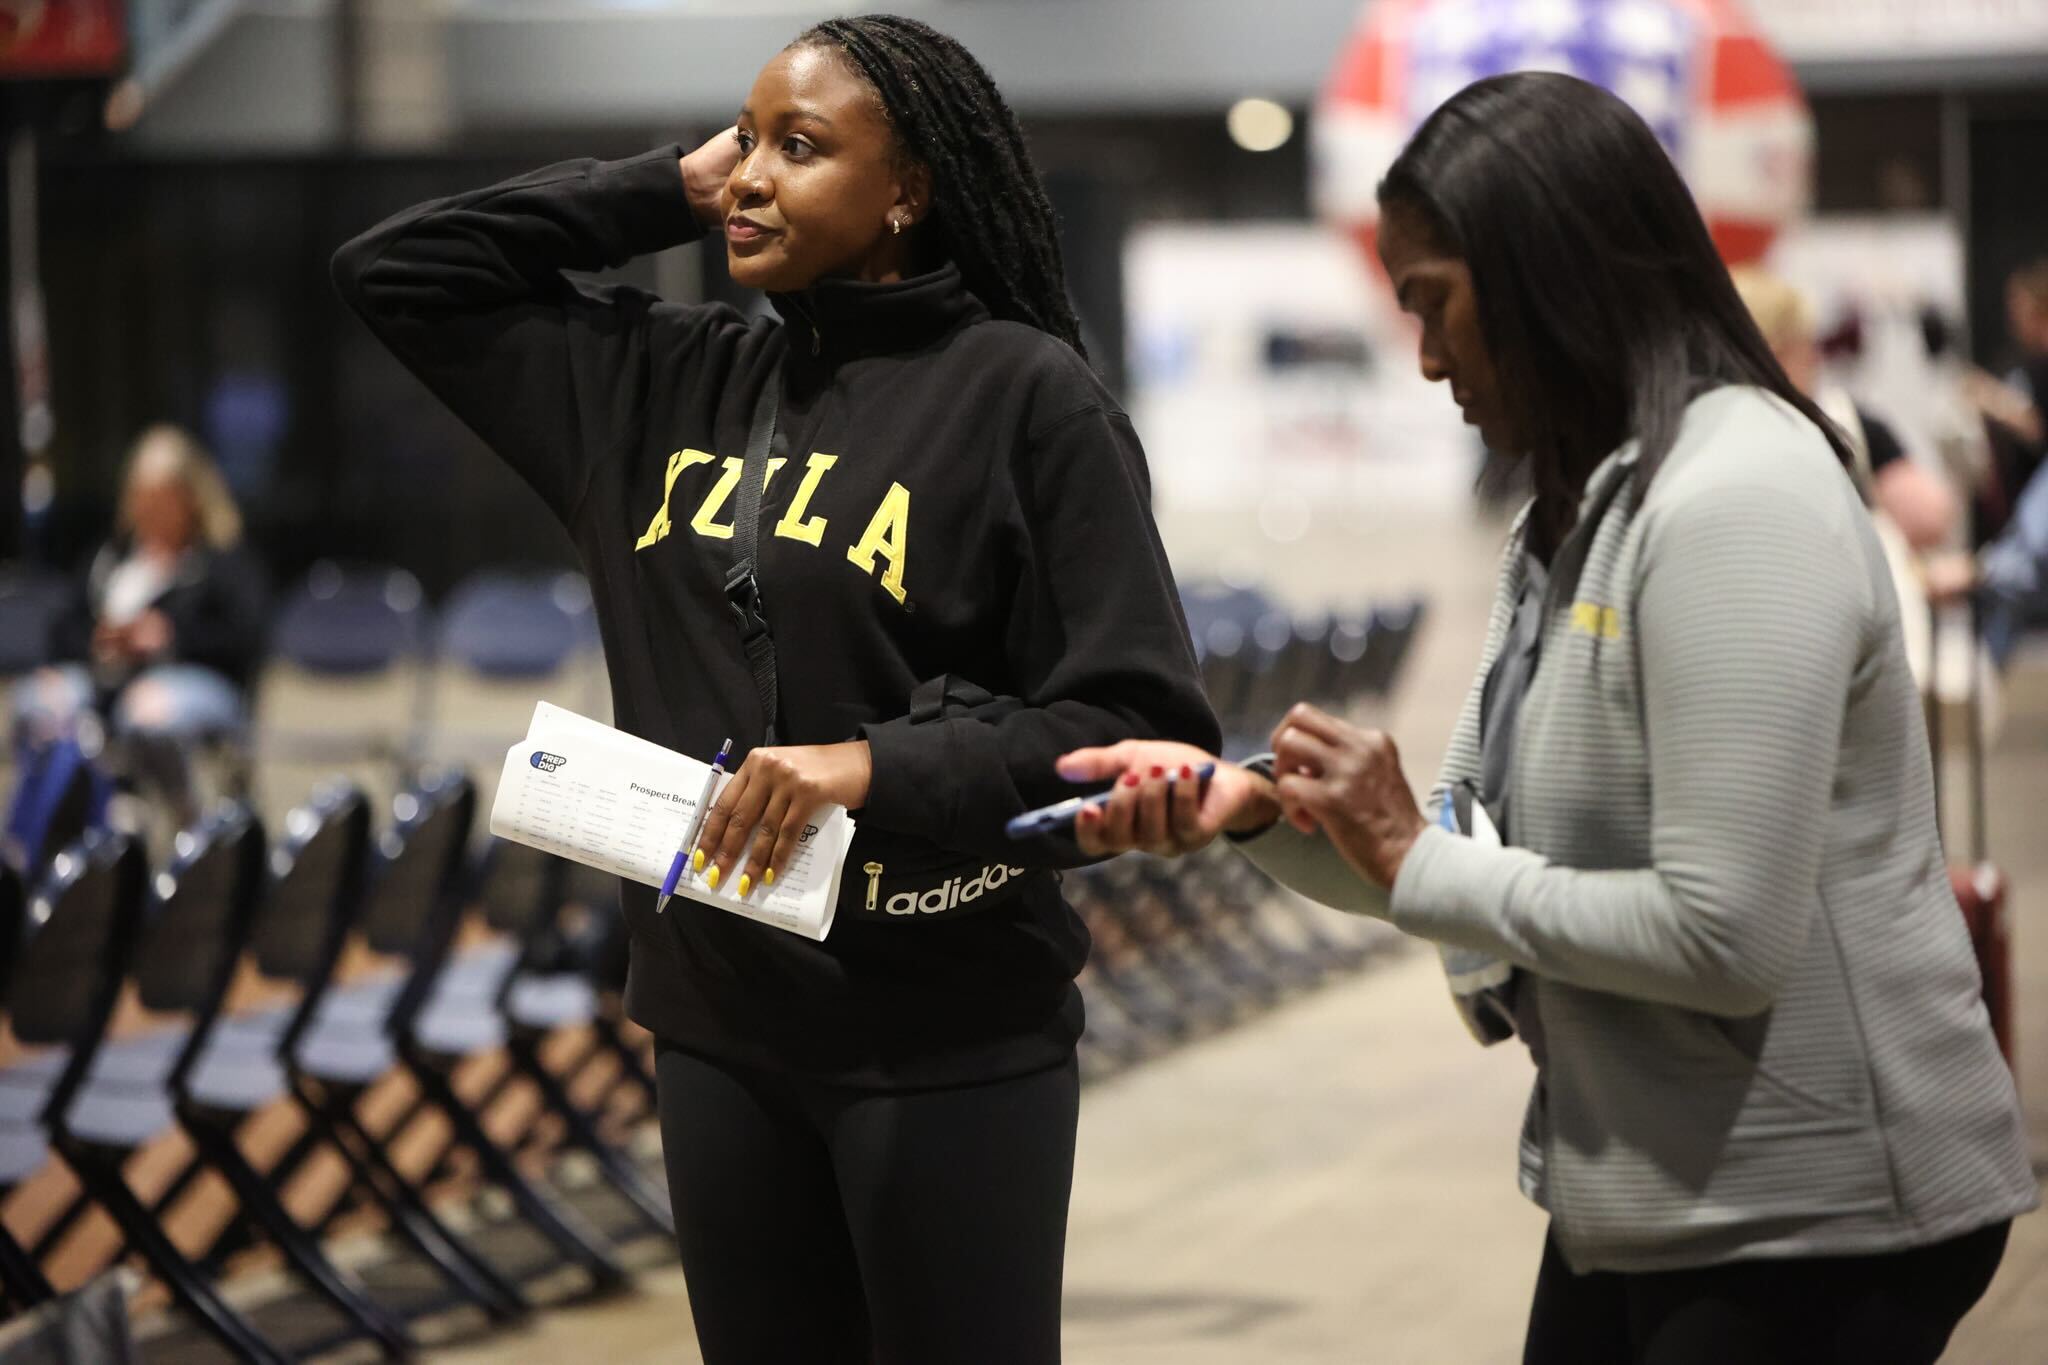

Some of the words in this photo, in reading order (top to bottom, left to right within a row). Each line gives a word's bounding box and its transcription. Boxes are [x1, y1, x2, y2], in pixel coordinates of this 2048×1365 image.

[537, 760, 555, 772] DIG
[541, 753, 566, 766] PREP
[630, 782, 670, 801] Prospect
[671, 794, 697, 808] Break
